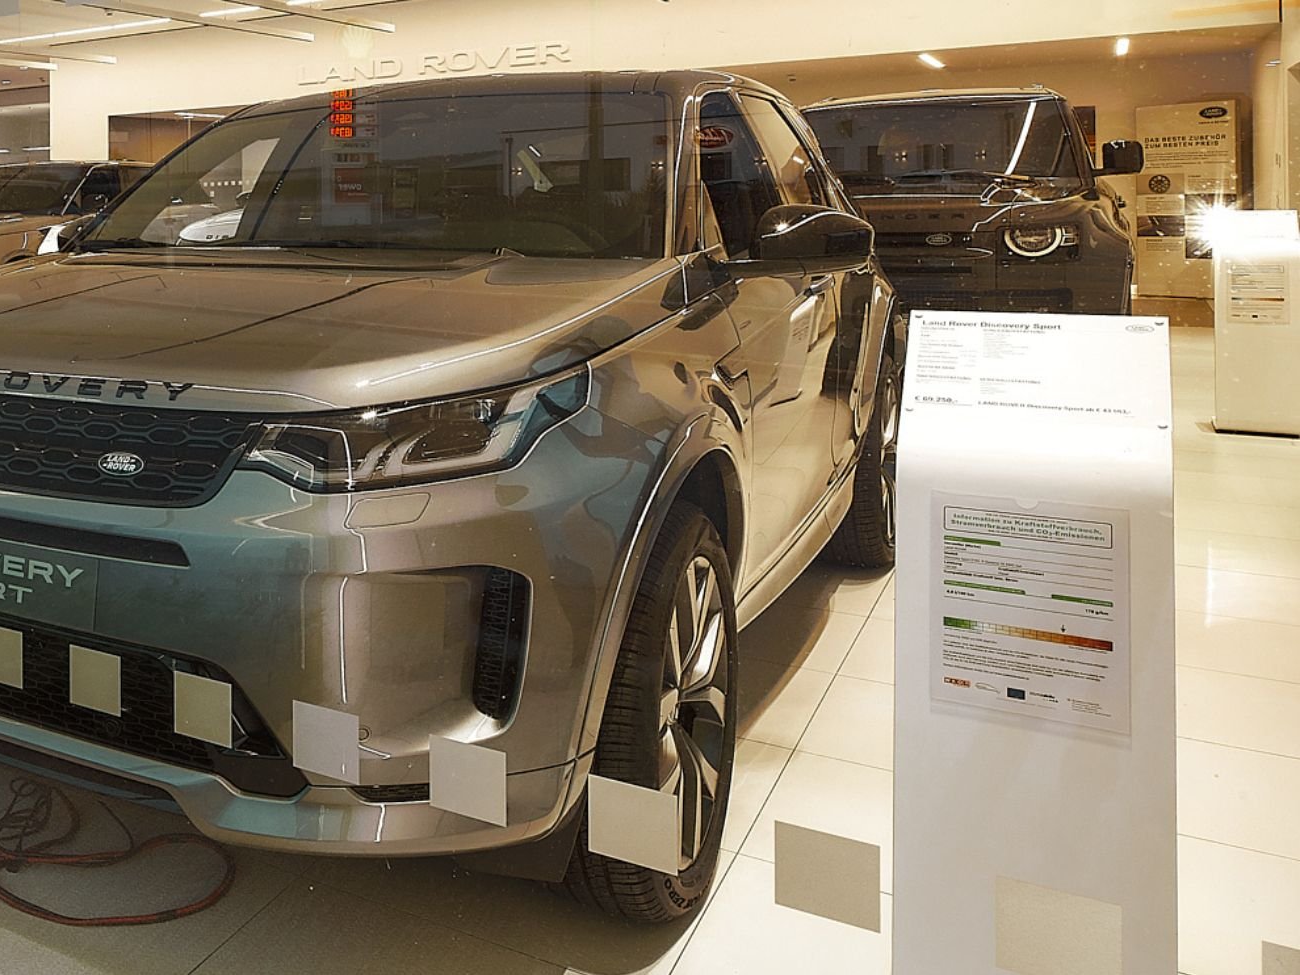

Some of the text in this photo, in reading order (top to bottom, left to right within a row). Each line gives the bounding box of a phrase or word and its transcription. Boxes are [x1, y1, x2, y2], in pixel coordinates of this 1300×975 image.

[298, 41, 572, 86] LAND ROVER
[1188, 133, 1226, 141] ZUBEHÖR
[980, 322, 1031, 330] Discovery
[107, 455, 131, 463] LAND
[106, 462, 136, 471] ROVER
[953, 513, 1001, 523] Information
